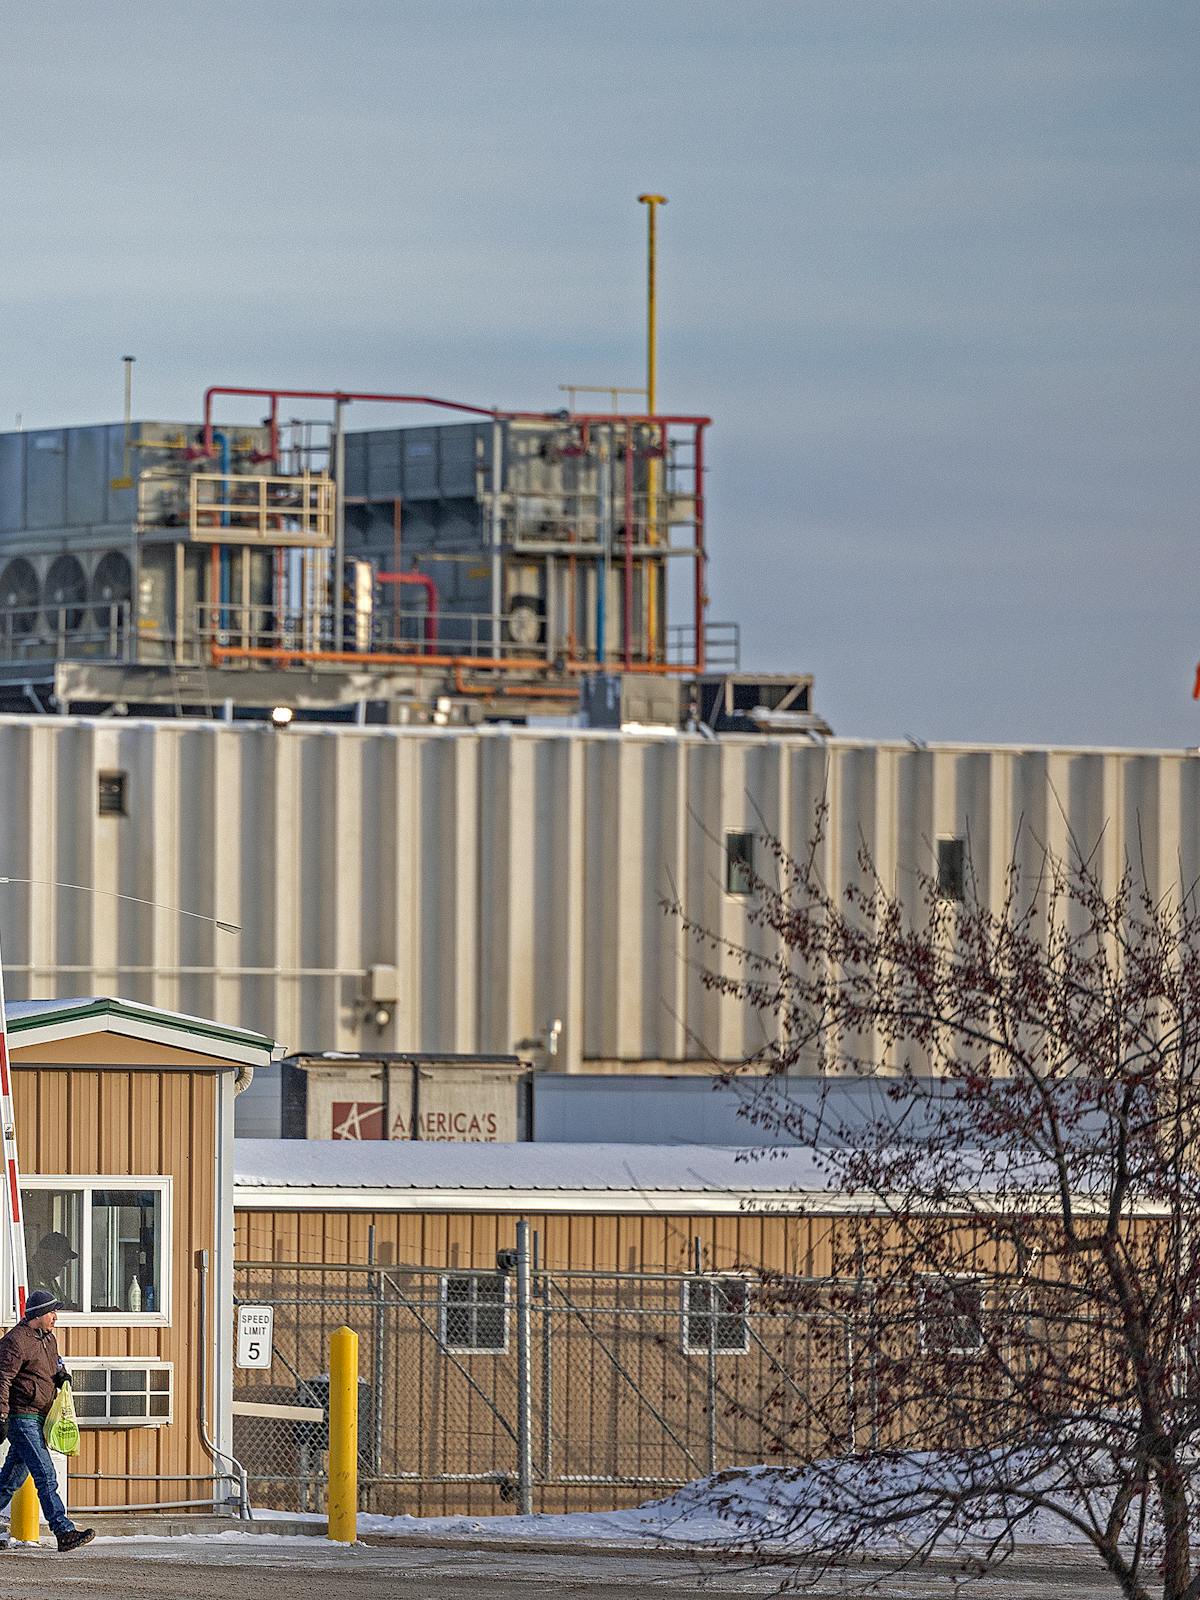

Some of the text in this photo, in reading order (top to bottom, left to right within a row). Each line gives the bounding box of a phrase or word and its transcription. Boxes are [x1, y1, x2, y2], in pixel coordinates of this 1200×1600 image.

[241, 1314, 270, 1324] SPEED
[243, 1326, 267, 1335] LIMIT
[248, 1342, 260, 1360] 5
